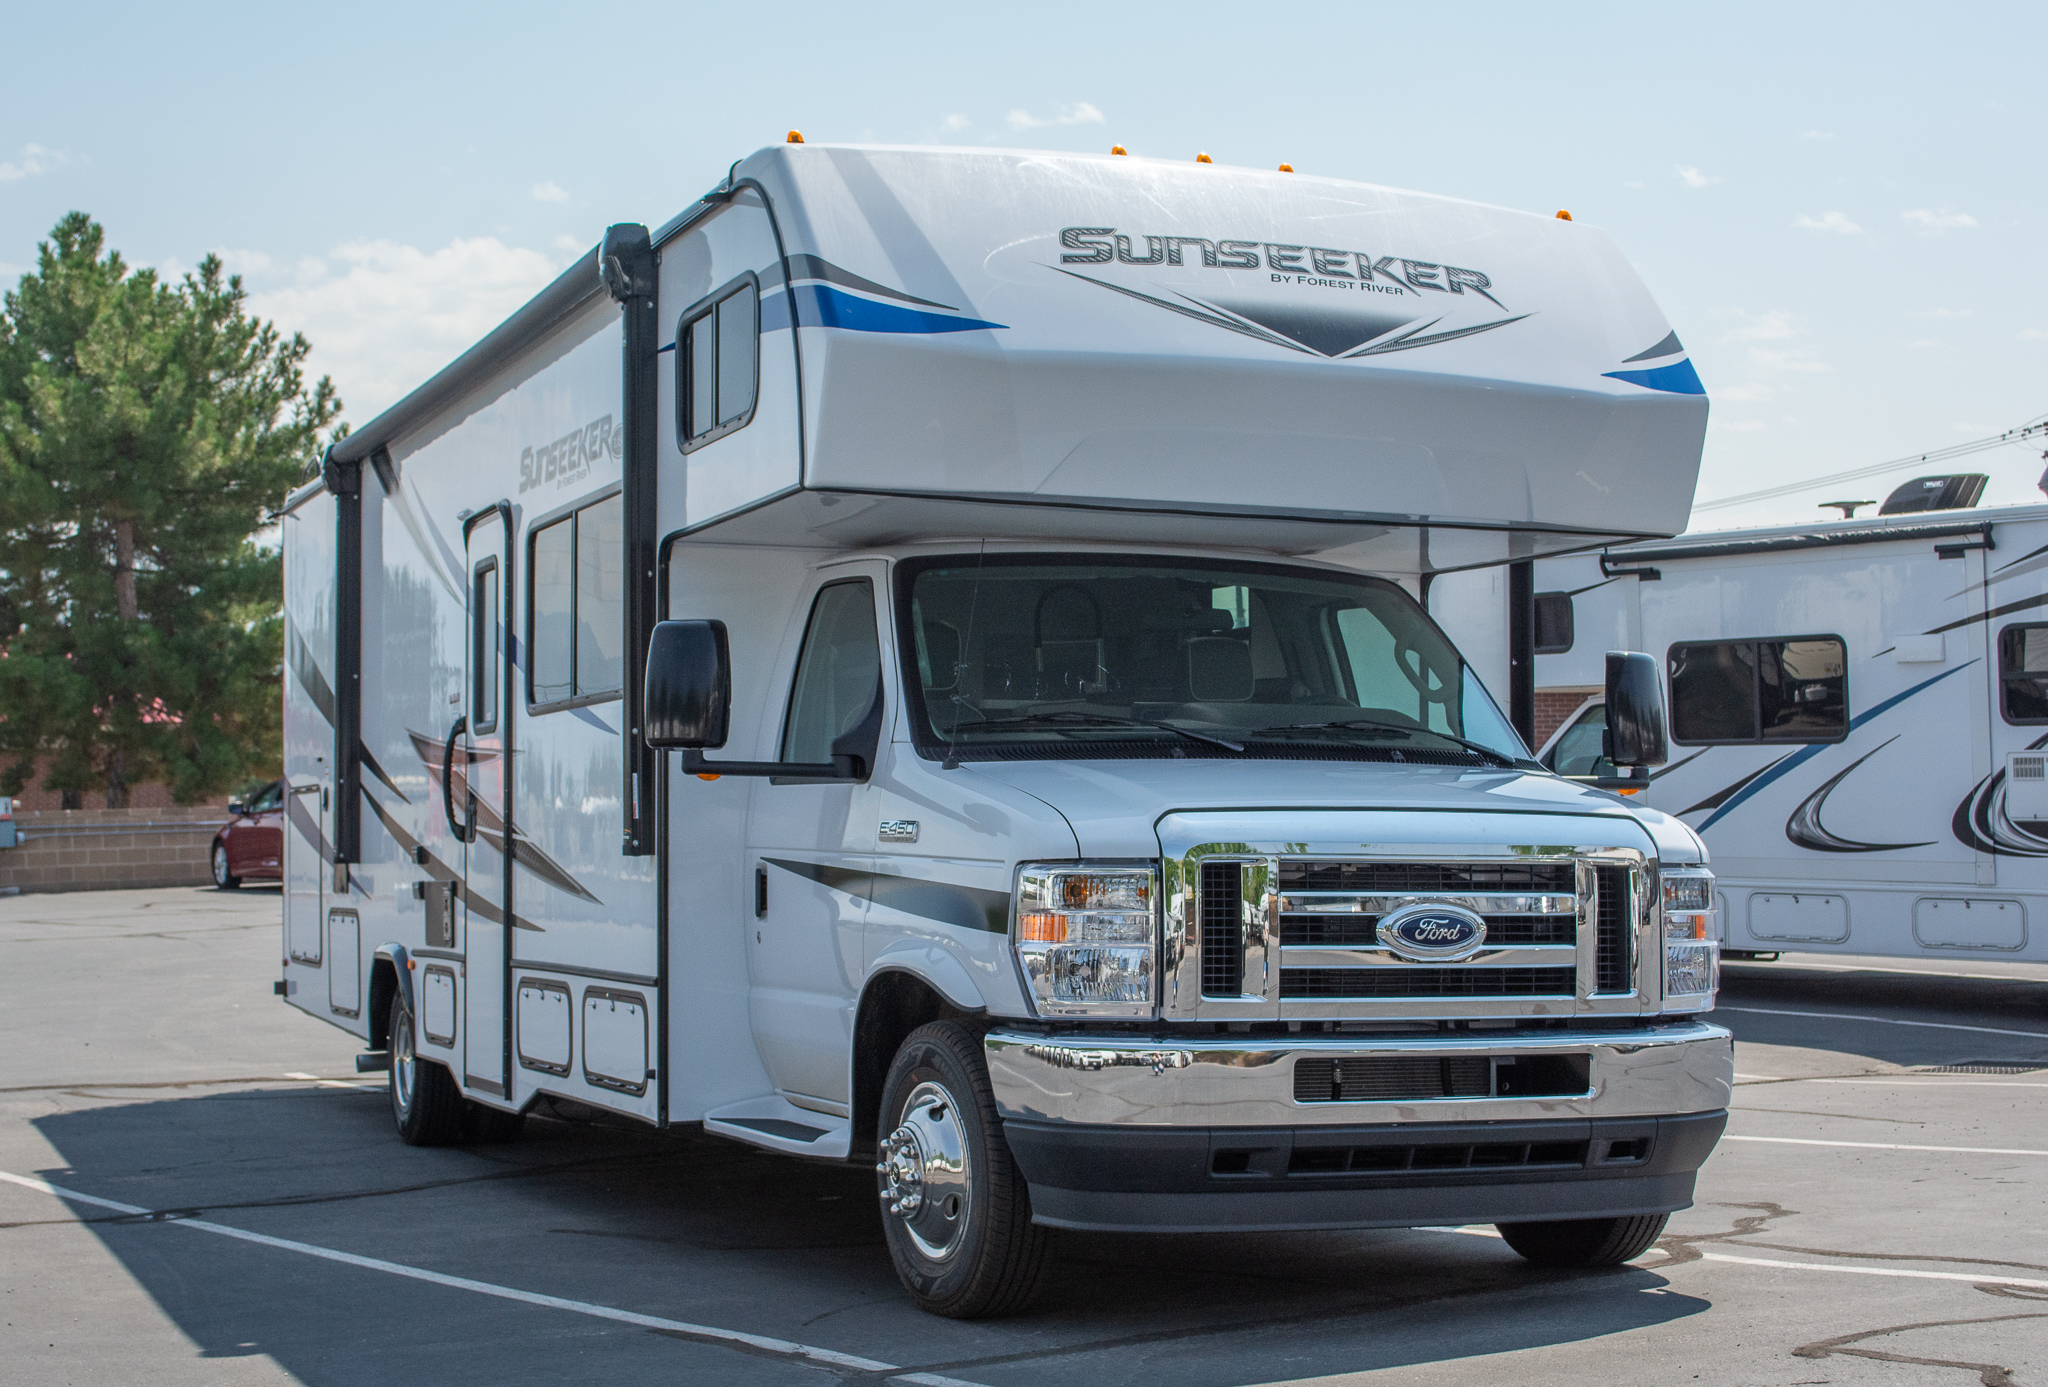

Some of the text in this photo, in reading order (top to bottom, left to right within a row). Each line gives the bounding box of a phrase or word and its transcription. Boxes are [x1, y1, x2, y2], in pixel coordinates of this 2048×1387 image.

[1270, 273, 1404, 296] BY FOREST RIVER
[1415, 918, 1461, 940] Ford
